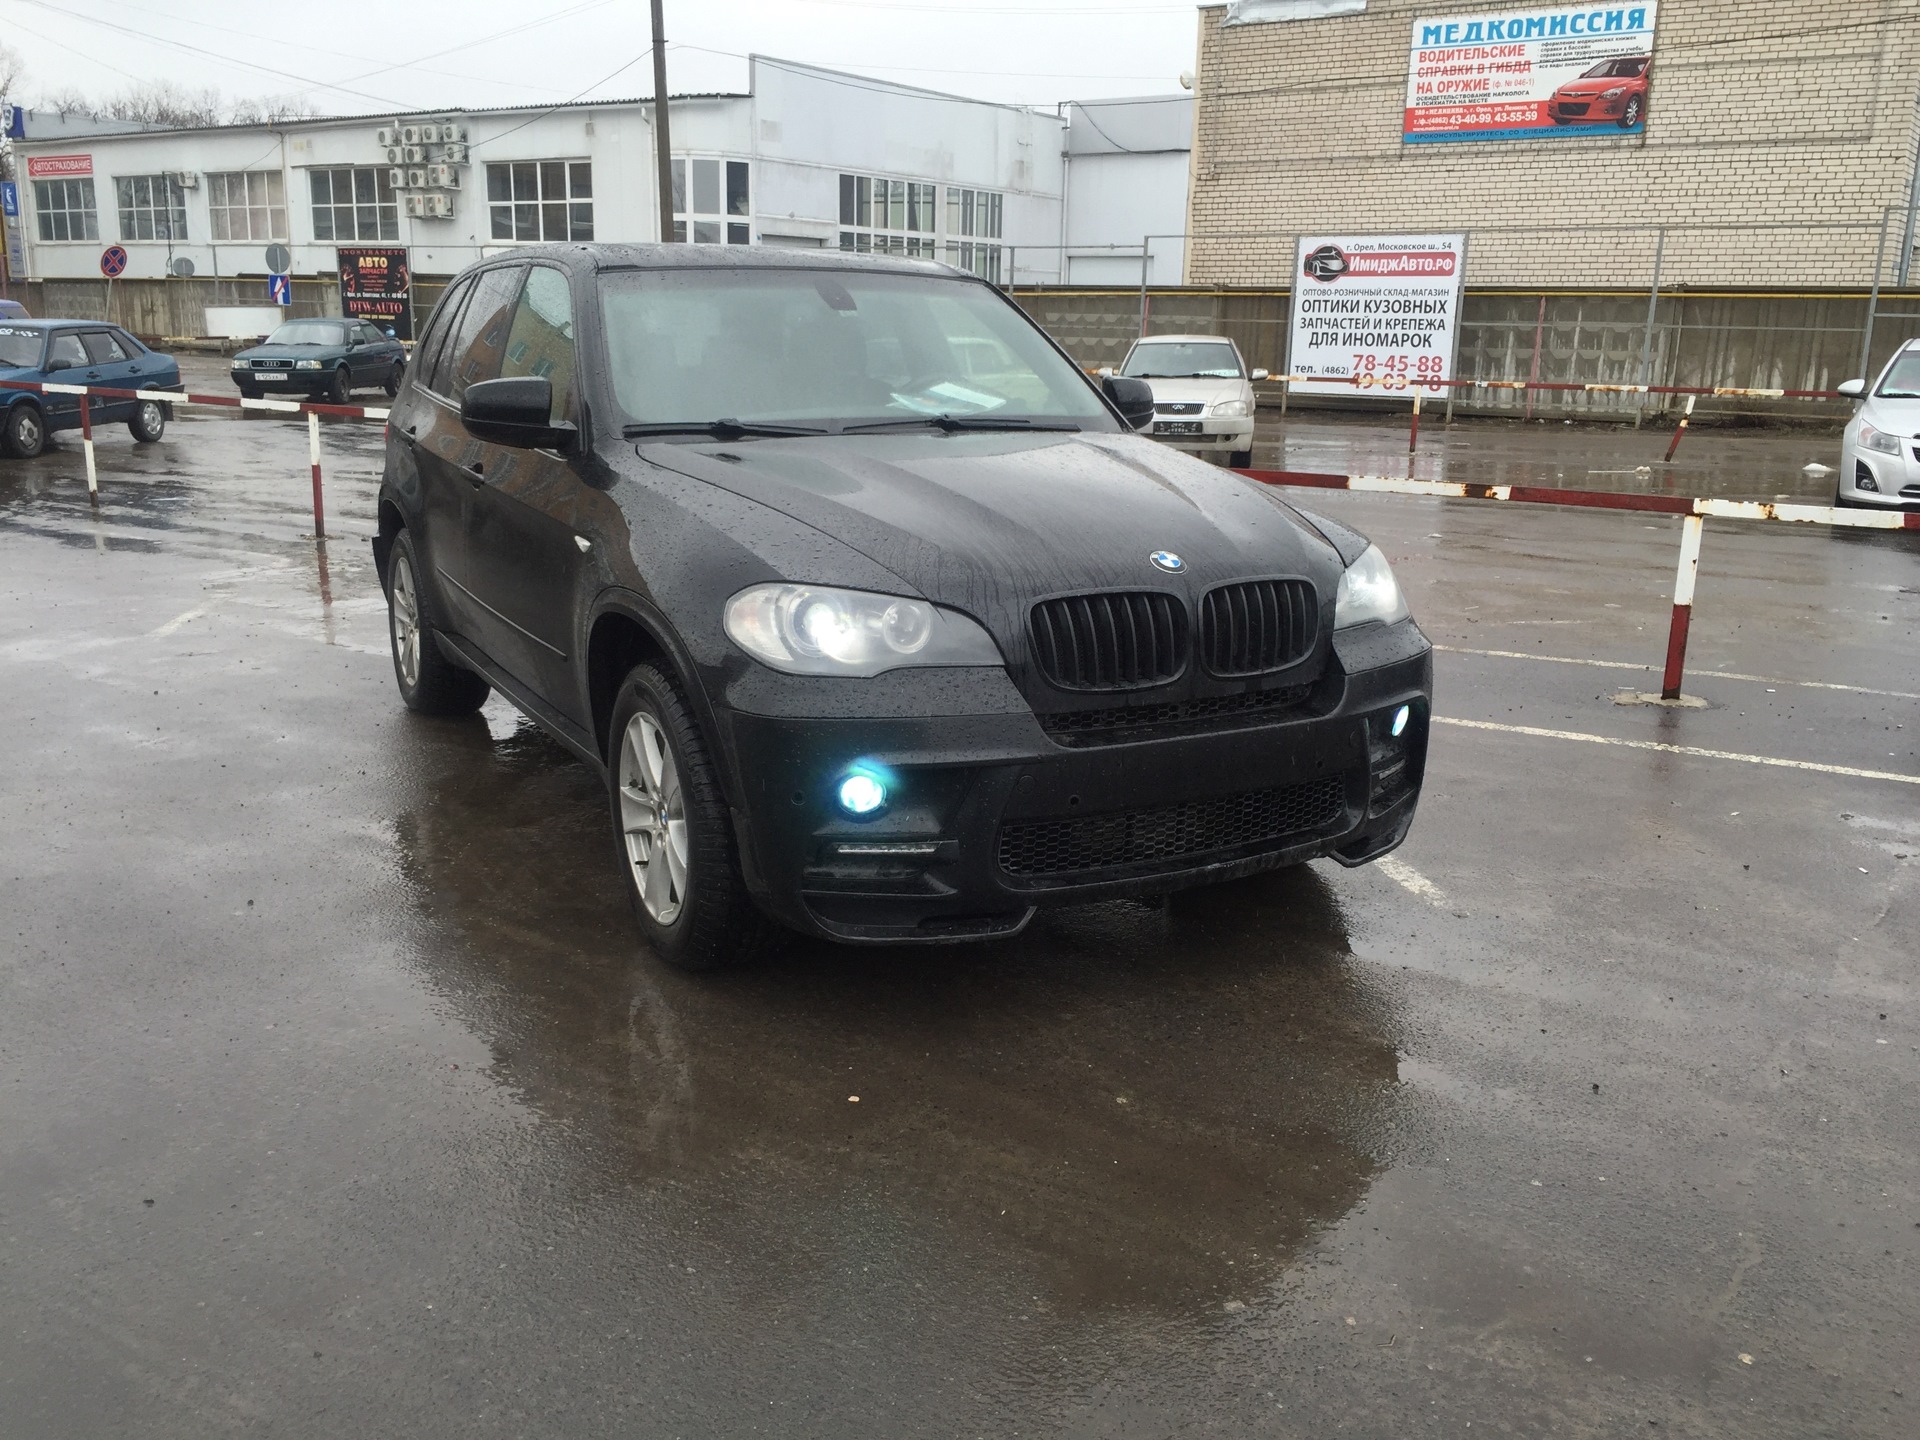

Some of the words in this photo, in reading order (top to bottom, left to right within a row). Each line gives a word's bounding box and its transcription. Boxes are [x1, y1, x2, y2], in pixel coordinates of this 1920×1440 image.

[1421, 8, 1647, 46] МЕДКОМИССИЯ
[1418, 44, 1526, 64] ВОДИТЕЛЬСКИЕ
[1417, 63, 1474, 78] СПРАВКИ
[1477, 63, 1485, 74] В
[1488, 60, 1531, 74] ГИБДД
[1416, 82, 1433, 94] НА
[1437, 78, 1490, 94] ОРУЖИЕ
[1416, 92, 1491, 101] ОСВИДЕТЕЛЬСТВОВАНИЕ
[1494, 111, 1538, 123] 43-55-59
[1415, 130, 1505, 139] ПРОКОНСУЛЬТИРУЙТЕСЬ
[1523, 126, 1592, 135] СПЕЦИАЛИСТАМИ
[33, 159, 91, 172] АВТОСТРАХОВАНИЕ
[1353, 243, 1376, 253] Орел,
[1377, 242, 1427, 251] Московское
[1441, 242, 1452, 250] 54
[358, 256, 388, 268] АВТО
[1302, 288, 1382, 297] ОПТОВО-РОЗНИЧНЫЙ
[1383, 288, 1450, 297] СКЛАД-МАГАЗИН
[349, 300, 403, 313] DTW-AUTO
[1301, 299, 1361, 313] ОПТИКИ
[1363, 299, 1448, 314] КУЗОВНЫХ
[1300, 316, 1371, 330] ЗАПЧАСТЕЙ
[1373, 318, 1382, 330] И
[1385, 318, 1446, 331] КРЕПЕЖА
[1308, 332, 1339, 349] ДЛЯ
[1342, 332, 1433, 348] ИНОМАРОК
[1294, 365, 1317, 374] тел.
[1321, 365, 1349, 375] (4862)
[1352, 354, 1444, 373] 78-45-88
